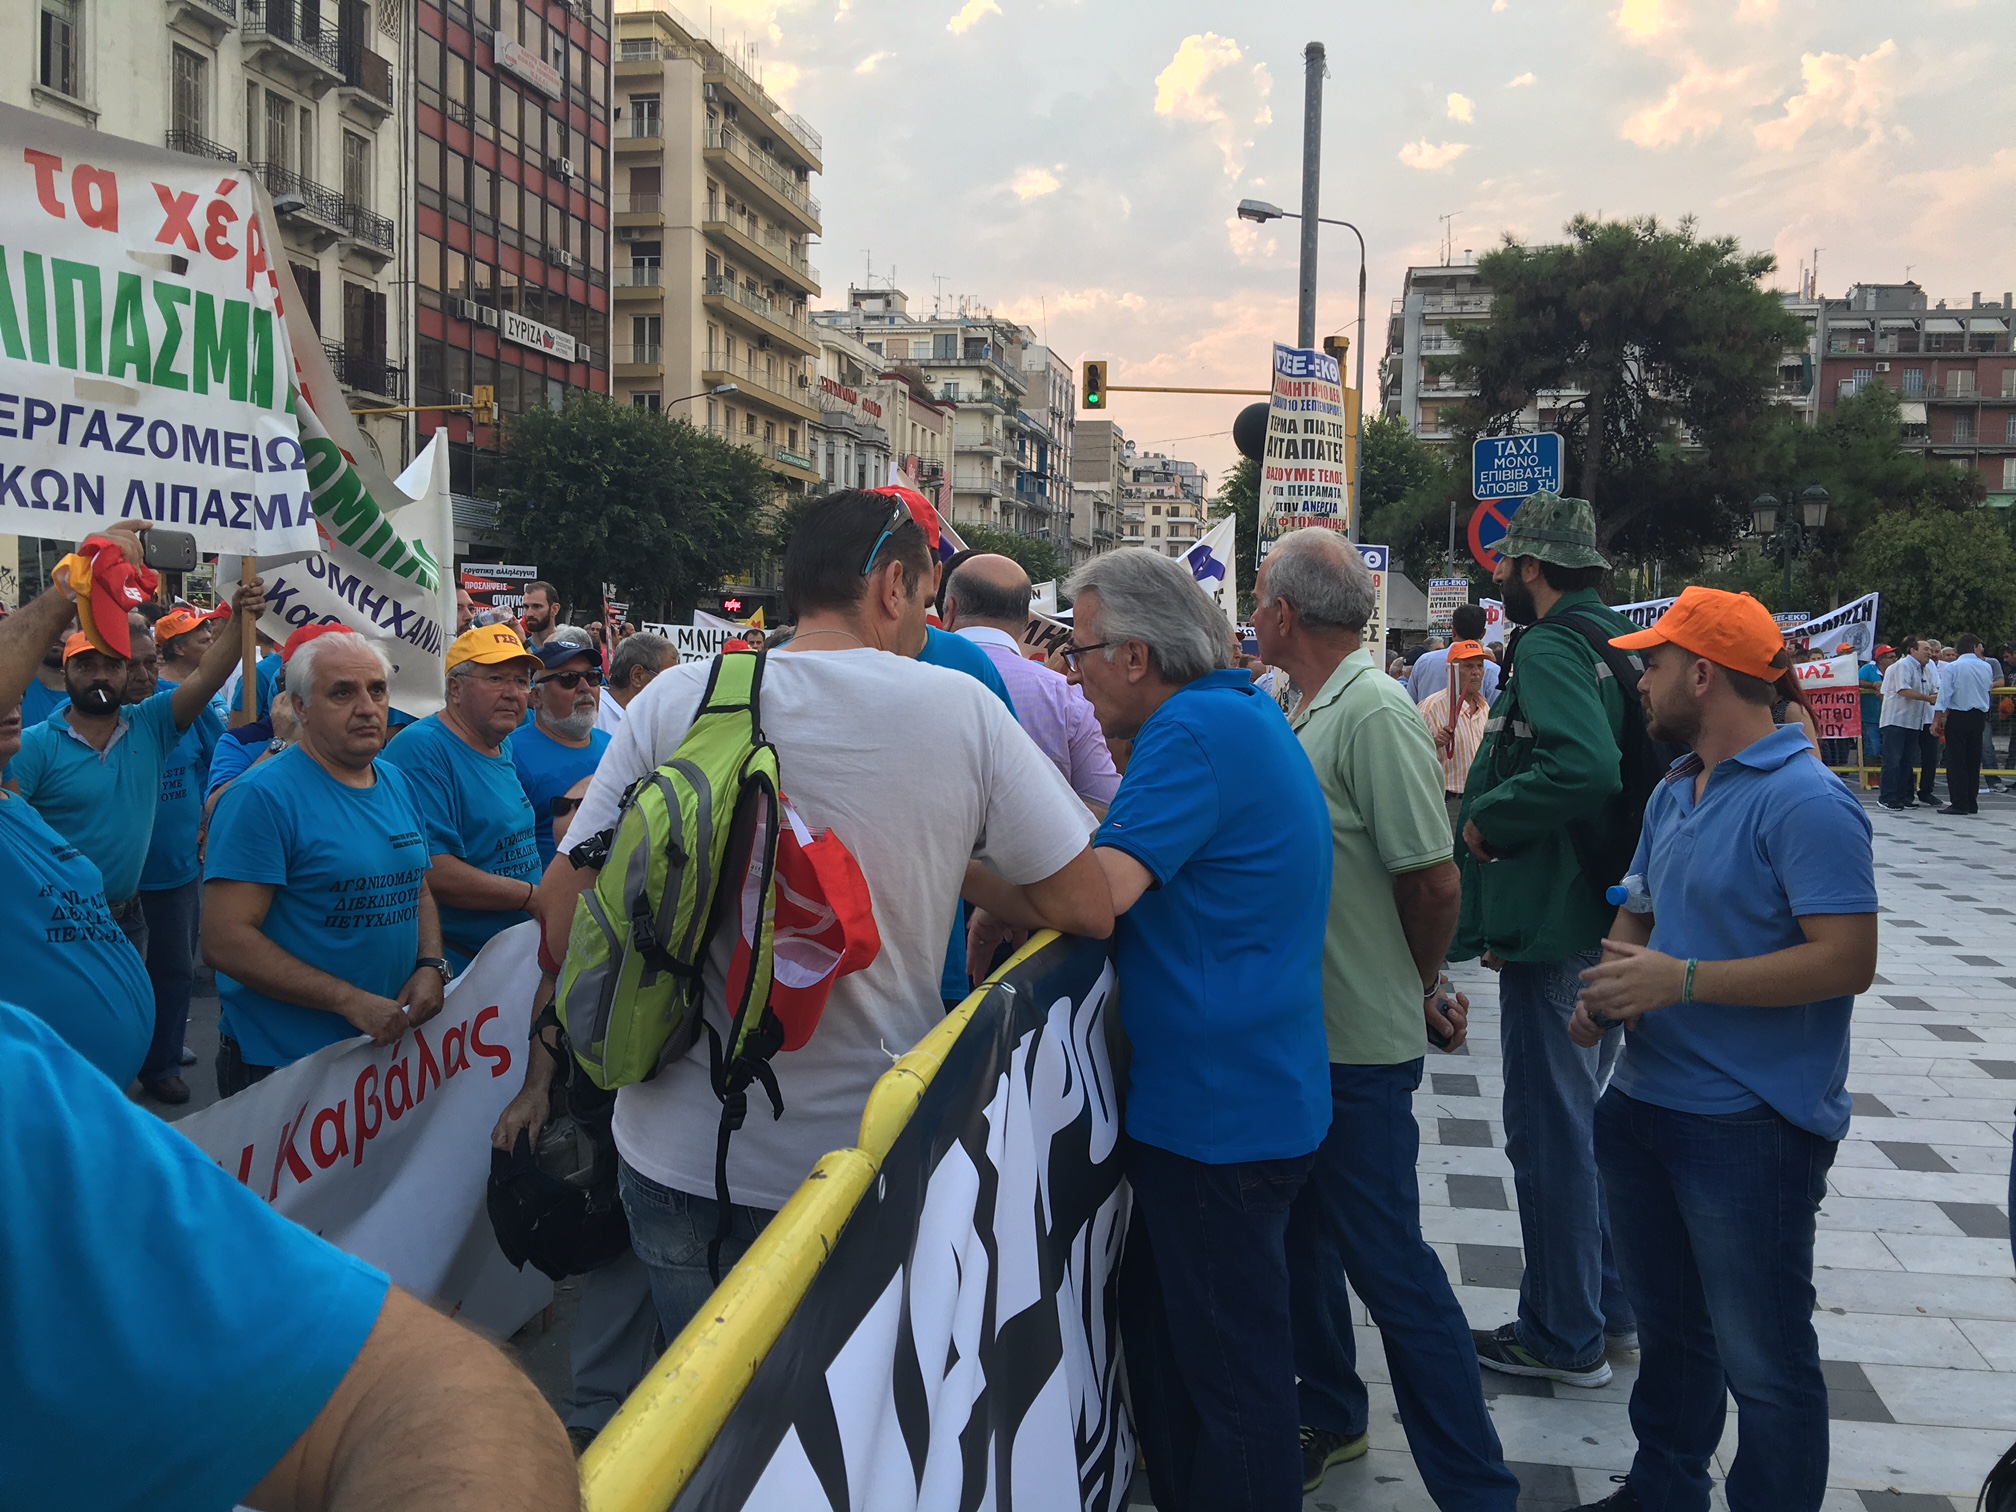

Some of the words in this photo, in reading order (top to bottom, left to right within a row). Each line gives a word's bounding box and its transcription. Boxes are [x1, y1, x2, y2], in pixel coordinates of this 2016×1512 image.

[24, 147, 118, 233] τα
[0, 244, 296, 413] ΛΙΠΑΣΜΑ
[508, 316, 542, 346] ΣΥΡΙΖΑ
[1288, 400, 1298, 412] 10
[1271, 415, 1298, 434] ΤΕΡΜΑ
[1304, 419, 1325, 436] ΠΙΑ
[1327, 421, 1343, 439] ΣΤΙΣ
[1267, 435, 1343, 464] ΑΥΤΑΠΑΤΕΣ
[1494, 455, 1539, 469] ΜΟΝΟ
[1266, 466, 1315, 482] ΒΑΖΟΥΜΕ
[1318, 469, 1343, 485] ΤΕΛΟΣ
[1481, 466, 1552, 482] ΕΠΙΒΙΒΑΣΗ
[1288, 485, 1342, 499] ΠΕΙΡΑΜΑΤΑ
[1302, 501, 1338, 514] ΑΝΕΡΓΙΑ
[464, 581, 508, 591] ΠΡΟΣΛΗΨΕΙΣ
[296, 554, 443, 657] ΟΜΗΧΑΝΙΑ
[268, 1005, 512, 1203] Καβάλας
